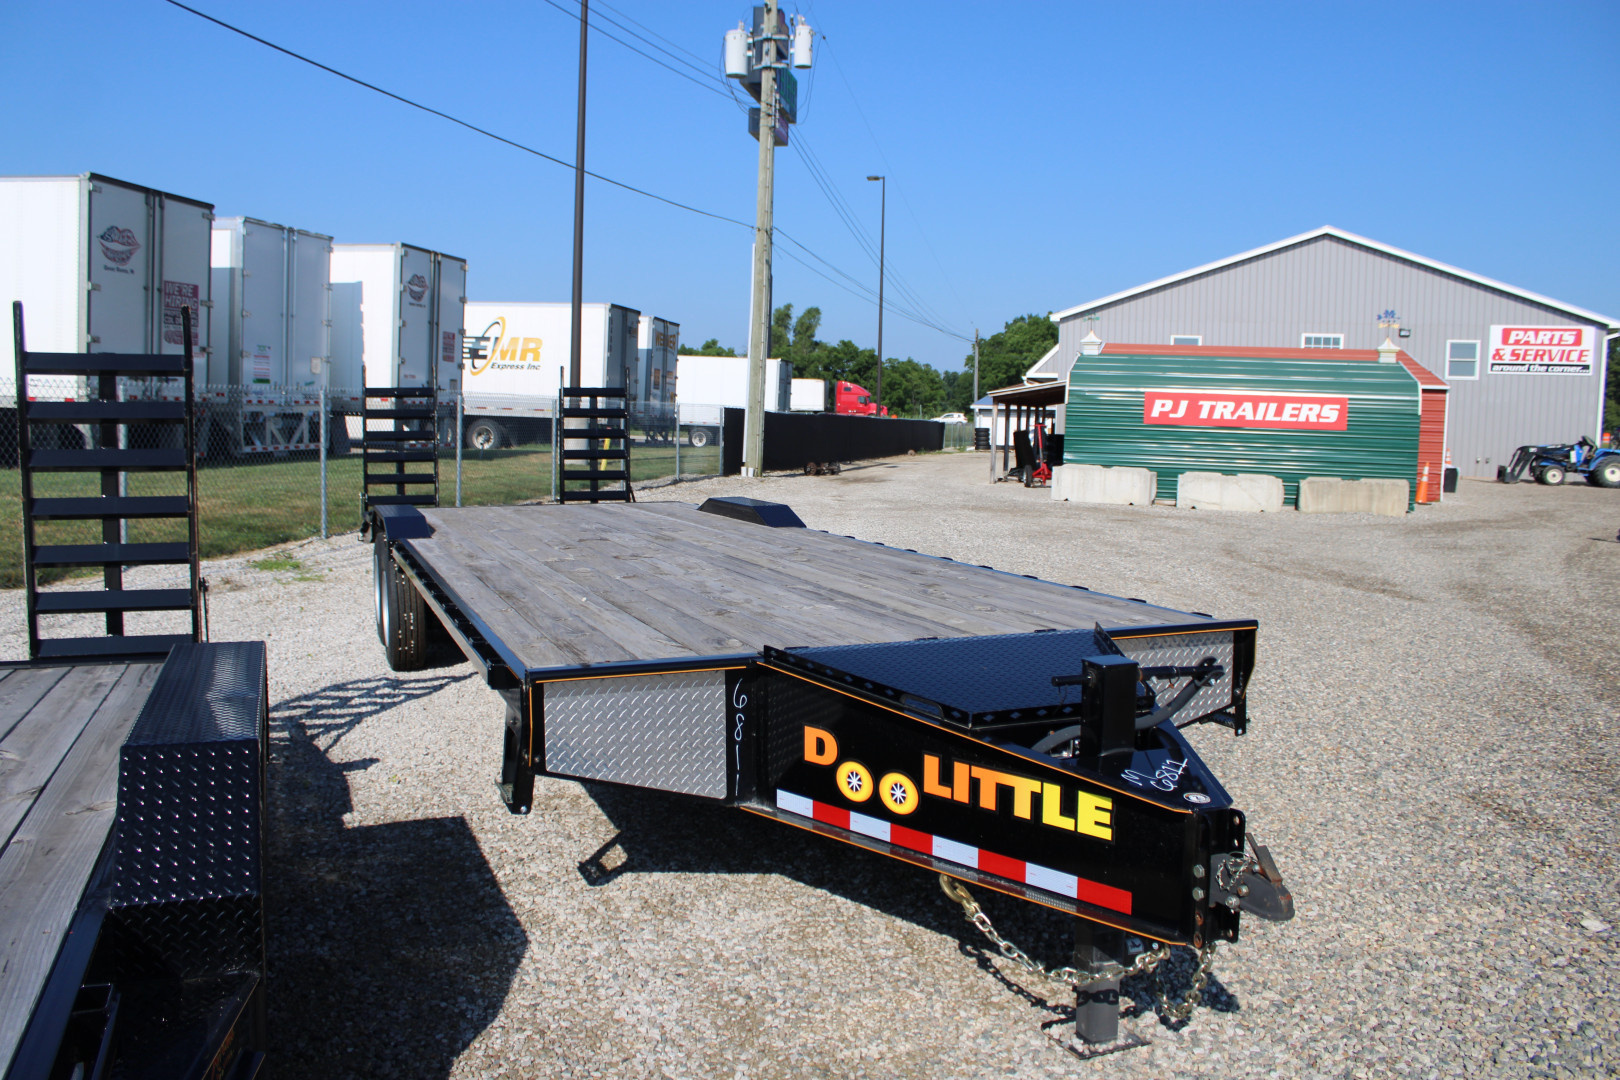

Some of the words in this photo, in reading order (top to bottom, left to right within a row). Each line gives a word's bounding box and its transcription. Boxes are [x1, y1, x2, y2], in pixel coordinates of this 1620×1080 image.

[165, 295, 198, 310] HIRING
[1507, 330, 1577, 345] PARTS
[1492, 348, 1506, 361] &
[1508, 348, 1590, 362] SERVICE
[490, 362, 525, 371] Express
[1530, 364, 1547, 372] the
[1150, 399, 1189, 418] PJ
[1198, 401, 1341, 423] TRAILERS
[803, 725, 1113, 841] DOOLITTLE
